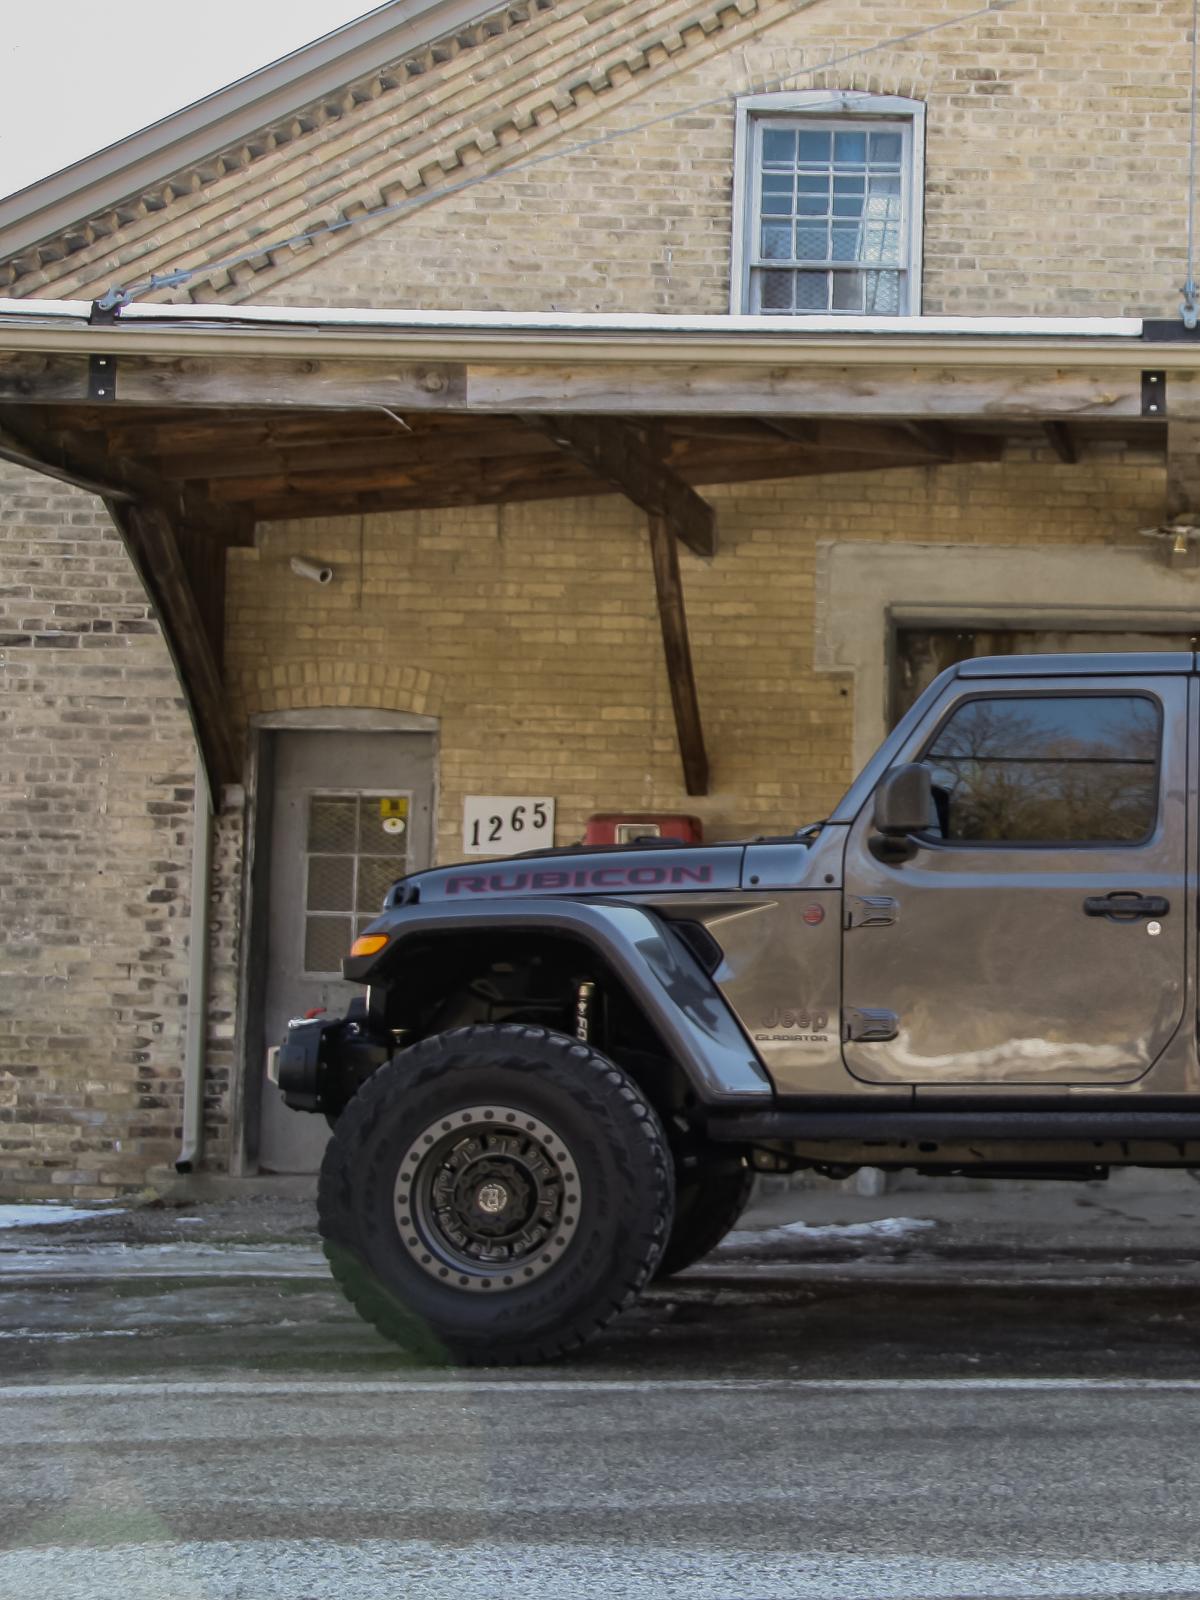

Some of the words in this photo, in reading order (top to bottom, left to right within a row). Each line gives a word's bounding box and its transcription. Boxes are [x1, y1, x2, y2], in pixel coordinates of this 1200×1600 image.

[471, 803, 547, 845] 1265
[446, 865, 713, 894] RUBICON
[577, 1016, 588, 1041] FO
[762, 1008, 828, 1032] Jeep
